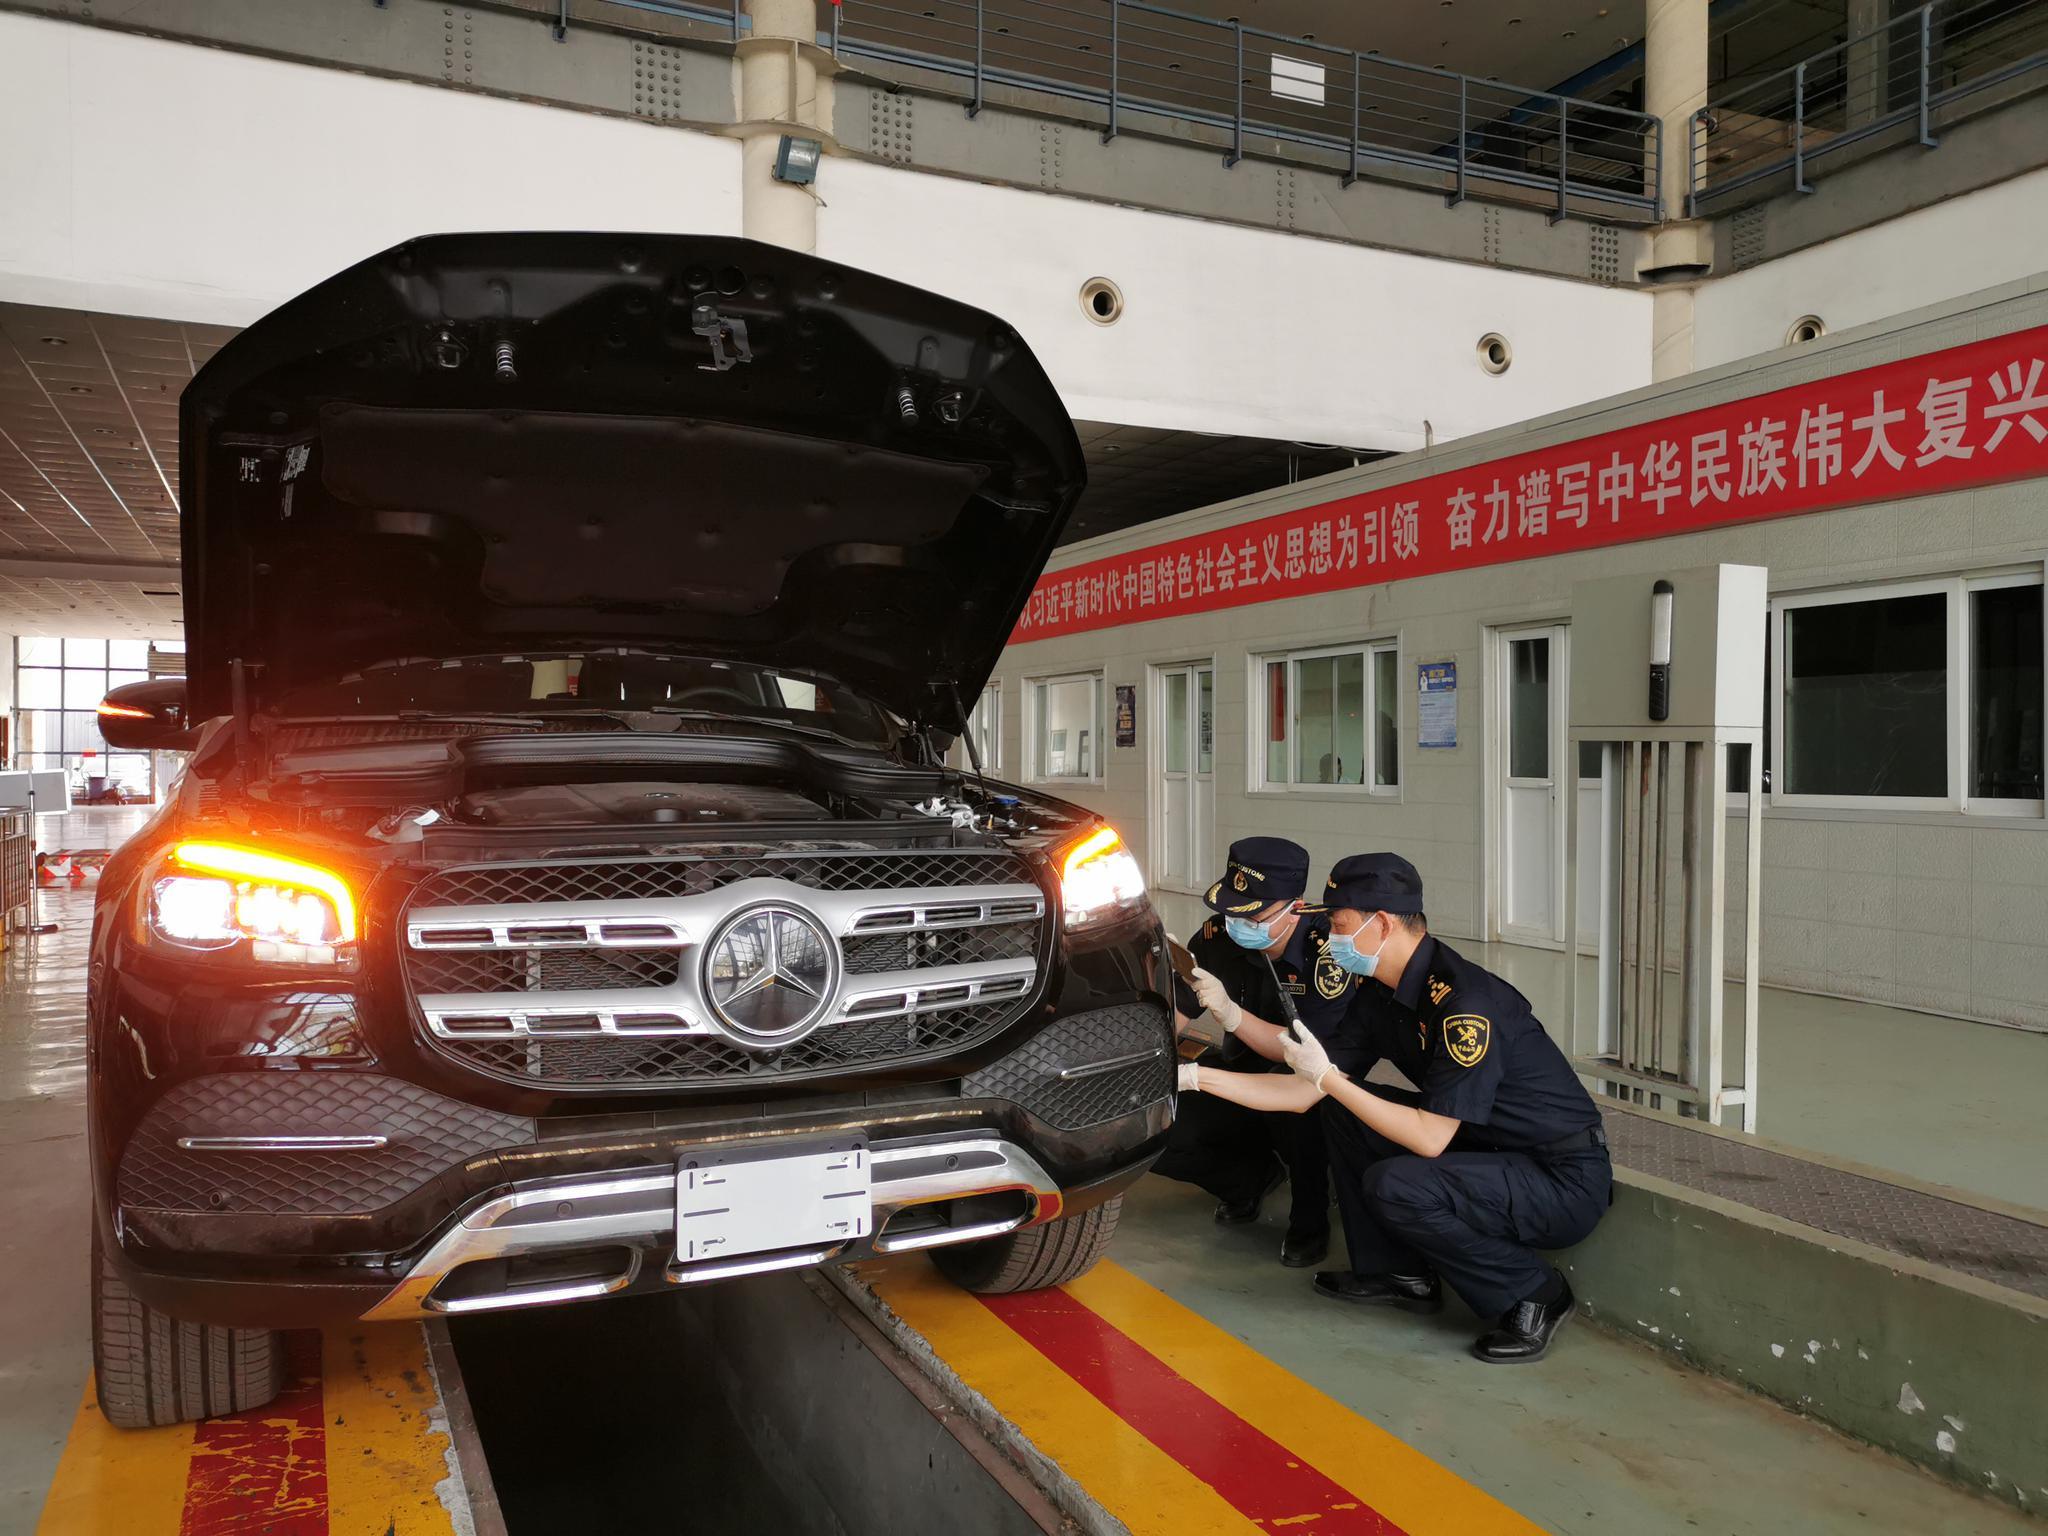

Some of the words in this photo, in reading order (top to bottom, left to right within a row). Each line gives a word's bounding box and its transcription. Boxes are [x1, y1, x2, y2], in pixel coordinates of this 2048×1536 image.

[1446, 358, 2048, 550] 奋力谱写中华民族伟大复兴
